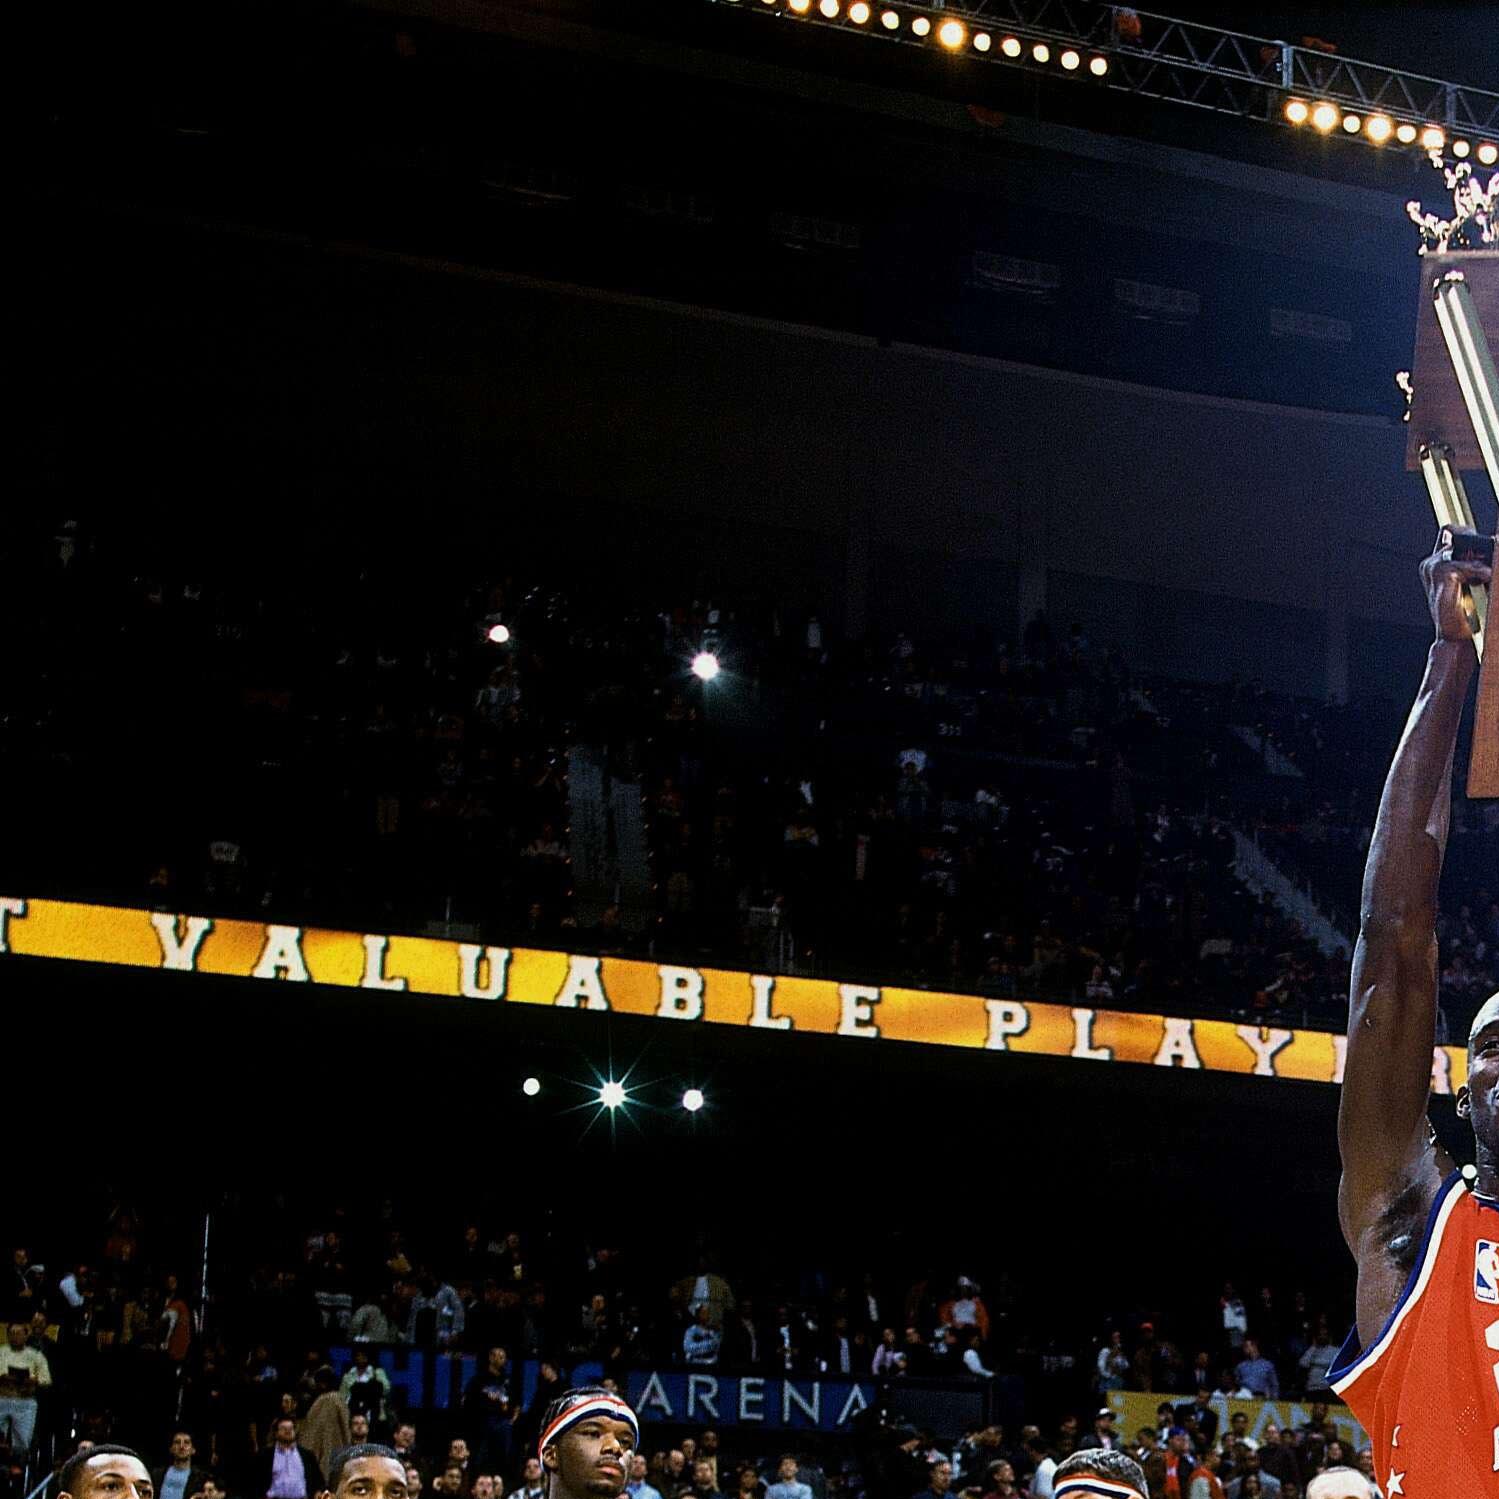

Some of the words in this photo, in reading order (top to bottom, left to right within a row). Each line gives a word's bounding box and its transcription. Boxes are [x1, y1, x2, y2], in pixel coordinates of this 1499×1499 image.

[151, 911, 881, 1037] VALUABLE
[984, 998, 1450, 1094] PLAY
[634, 1370, 868, 1426] ARENA
